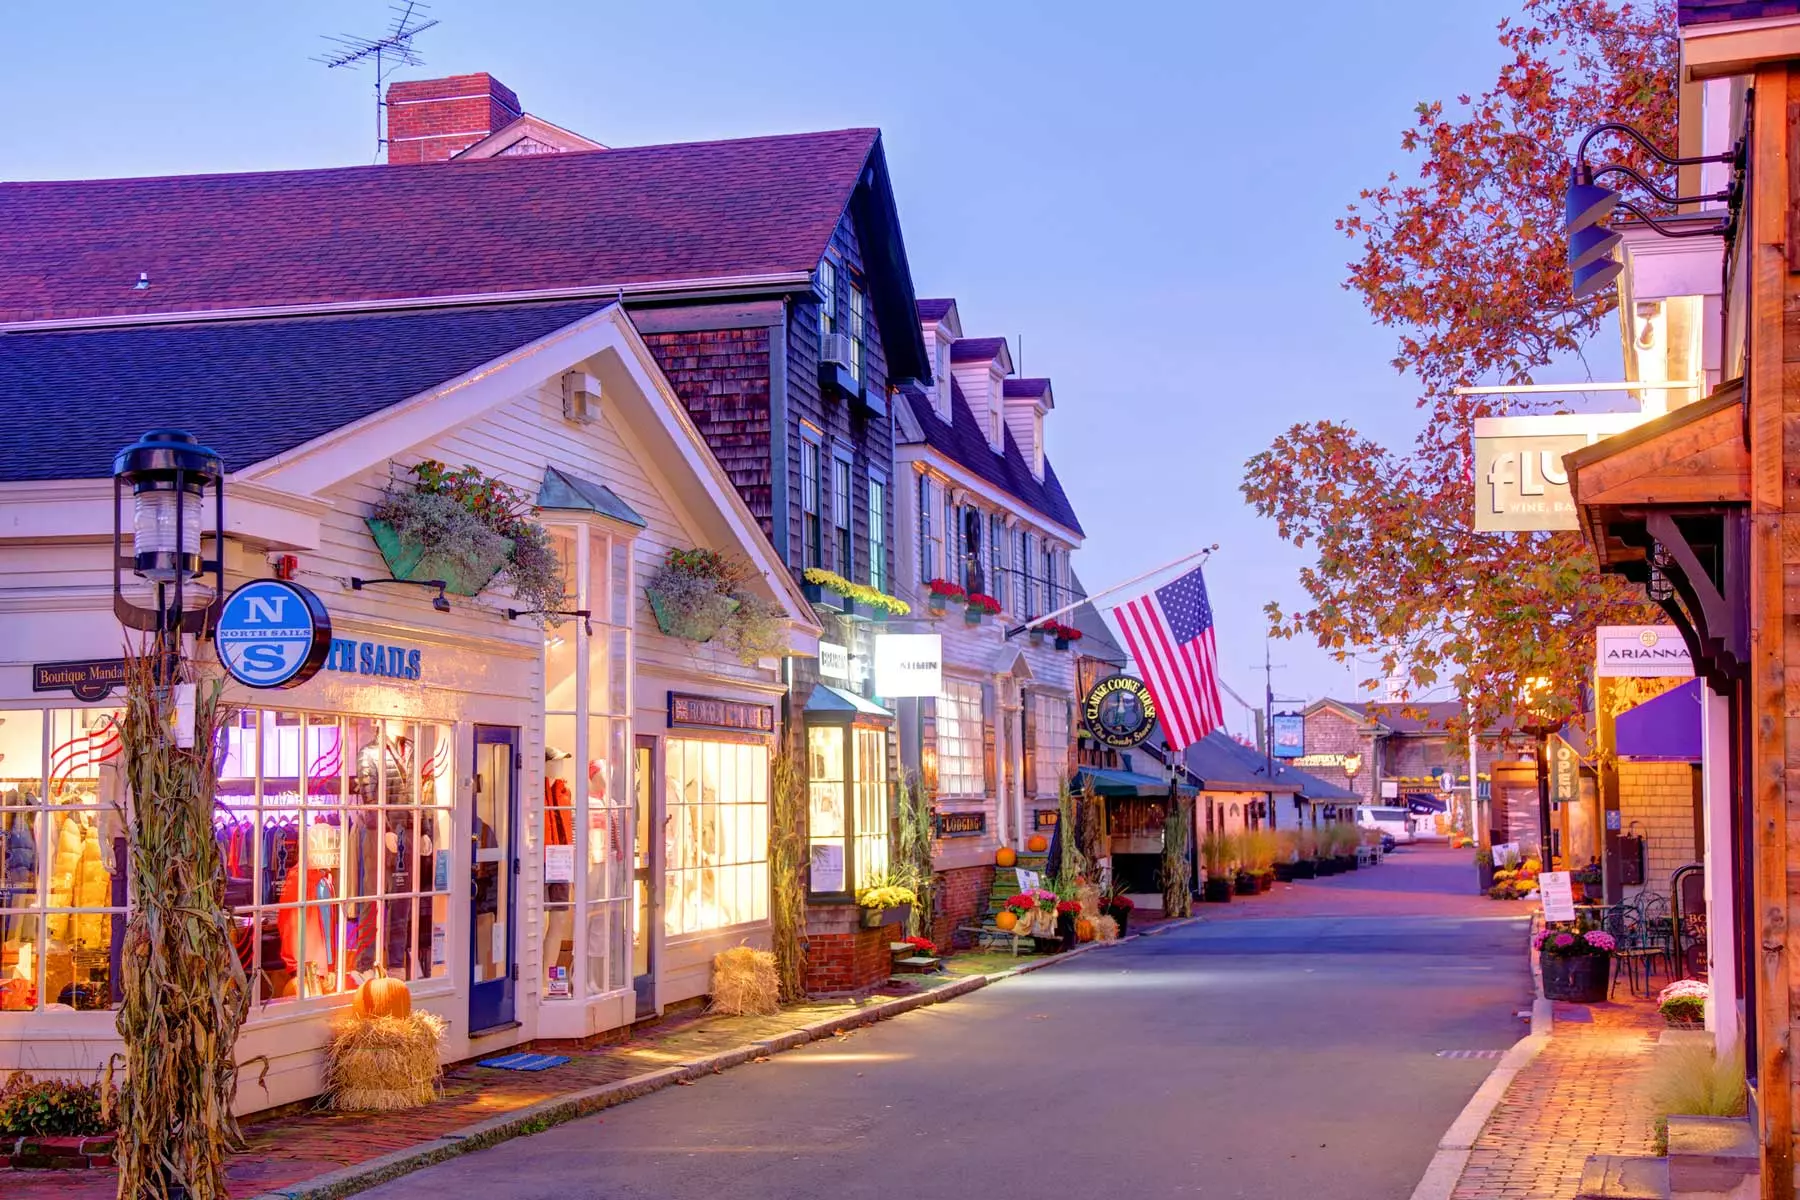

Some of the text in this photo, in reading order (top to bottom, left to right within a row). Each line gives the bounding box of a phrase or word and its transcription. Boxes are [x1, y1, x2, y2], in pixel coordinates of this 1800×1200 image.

[243, 596, 289, 623] N
[220, 628, 311, 637] NORTH SAILS
[243, 644, 287, 673] S
[360, 642, 421, 681] SAILS
[1607, 648, 1691, 659] ARIANNA
[40, 667, 87, 685] Boutique
[1087, 678, 1156, 720] CLARKE COOKE HOUSE
[1106, 734, 1133, 746] Candy
[1557, 747, 1571, 798] OPEN
